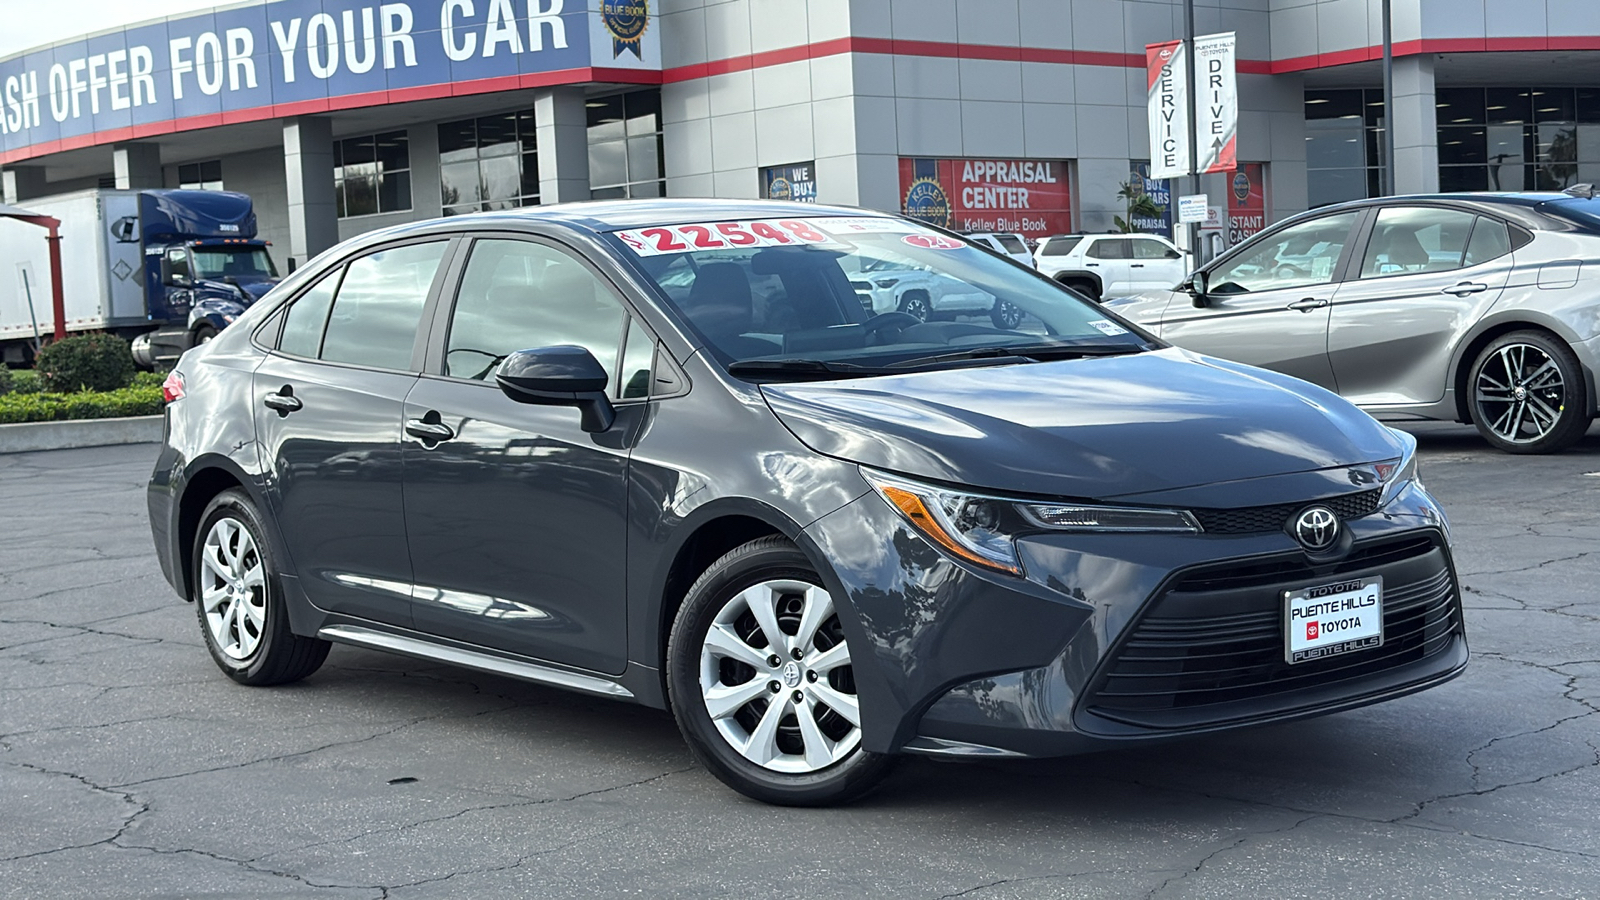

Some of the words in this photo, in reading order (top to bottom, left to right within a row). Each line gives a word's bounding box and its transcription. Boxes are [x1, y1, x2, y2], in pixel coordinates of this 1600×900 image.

[604, 4, 624, 15] BLUE
[625, 6, 645, 16] BOOK
[1195, 43, 1218, 51] PUENTE
[49, 45, 157, 122] OFFER
[170, 26, 258, 100] FOR
[271, 3, 418, 83] YOUR
[440, 0, 568, 61] CAR
[1209, 59, 1223, 135] DRIVE
[1161, 64, 1176, 168] SERVICE
[792, 167, 809, 182] WE
[962, 161, 1056, 183] APPRAISAL
[793, 181, 814, 197] BUY
[1146, 179, 1163, 191] BUY
[912, 185, 943, 202] KELLEY
[962, 187, 1029, 209] CENTER
[908, 205, 926, 217] BLUE
[927, 205, 946, 217] BOOK
[964, 218, 995, 232] Kelley
[997, 218, 1020, 231] Blue
[1022, 217, 1047, 231] Book
[1133, 218, 1167, 229] PPRAISAL
[1228, 216, 1262, 229] NSTANT
[918, 235, 951, 249] 24
[1312, 580, 1360, 597] TOYOTA
[1291, 601, 1339, 621] PUENTE
[1341, 594, 1376, 612] HILLS
[1321, 617, 1361, 634] TOYOTA
[1294, 644, 1343, 661] PUENTE
[1343, 637, 1379, 652] HILLS
